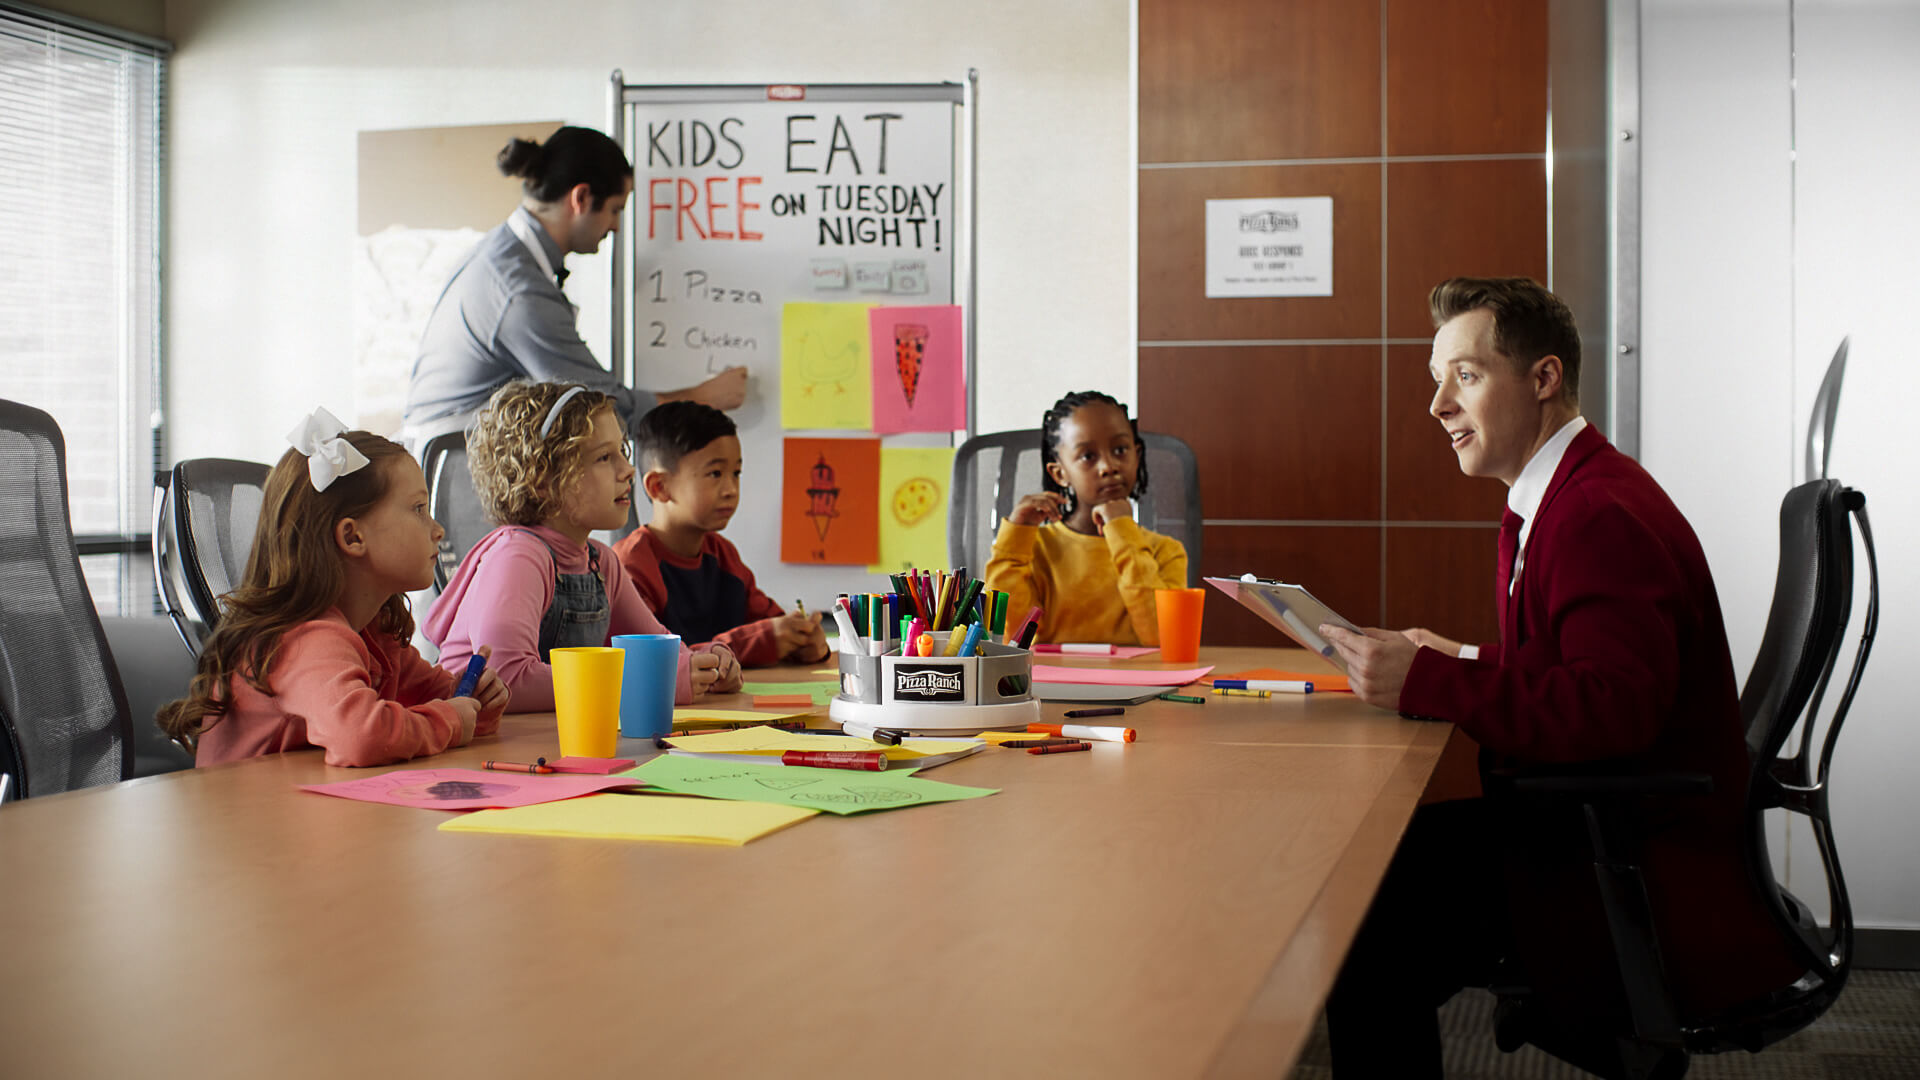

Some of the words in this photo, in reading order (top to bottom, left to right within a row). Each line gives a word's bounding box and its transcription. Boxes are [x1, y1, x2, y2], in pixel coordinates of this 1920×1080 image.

[648, 118, 744, 170] KIDS
[786, 113, 904, 175] EAT
[648, 176, 764, 241] FREE
[771, 193, 807, 216] ON
[817, 183, 945, 216] TUESDAY
[818, 217, 941, 252] NIGHT!
[649, 269, 668, 303] 1
[684, 269, 763, 304] Pizza
[649, 320, 667, 348] 2
[684, 326, 757, 351] Chicken
[897, 675, 927, 690] Pizza
[927, 673, 961, 691] Ranch
